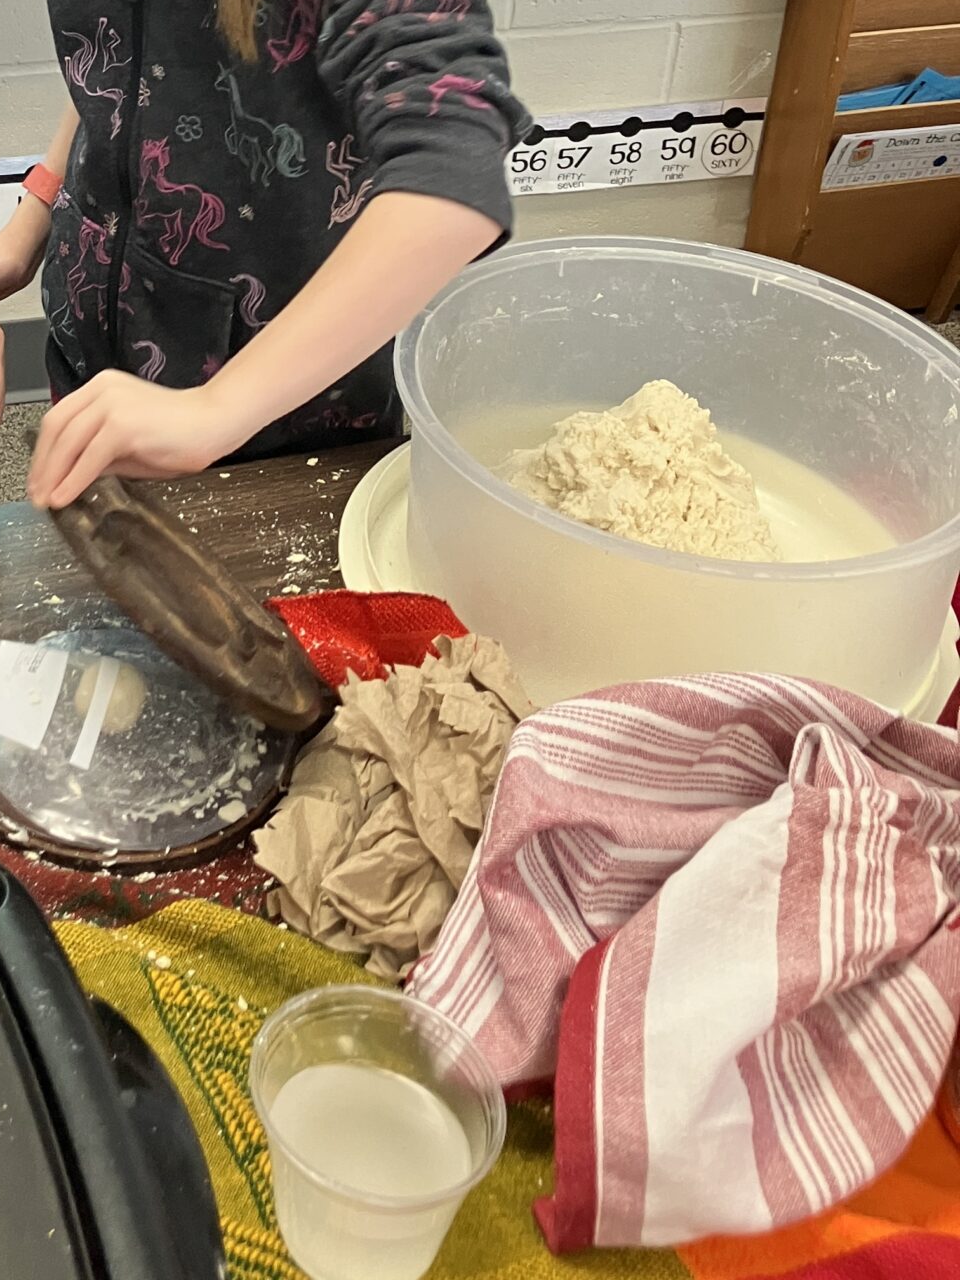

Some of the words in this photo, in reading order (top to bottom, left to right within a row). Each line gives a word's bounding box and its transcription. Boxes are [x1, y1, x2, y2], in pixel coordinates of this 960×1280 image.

[885, 138, 921, 149] Down
[926, 132, 948, 145] the
[511, 149, 547, 173] 56
[556, 146, 593, 170] 57
[609, 141, 643, 165] 58
[660, 136, 697, 161] 59
[710, 132, 748, 156] 60
[520, 185, 533, 193] six
[557, 181, 585, 190] seven
[610, 175, 634, 185] eight
[664, 172, 684, 181] nine
